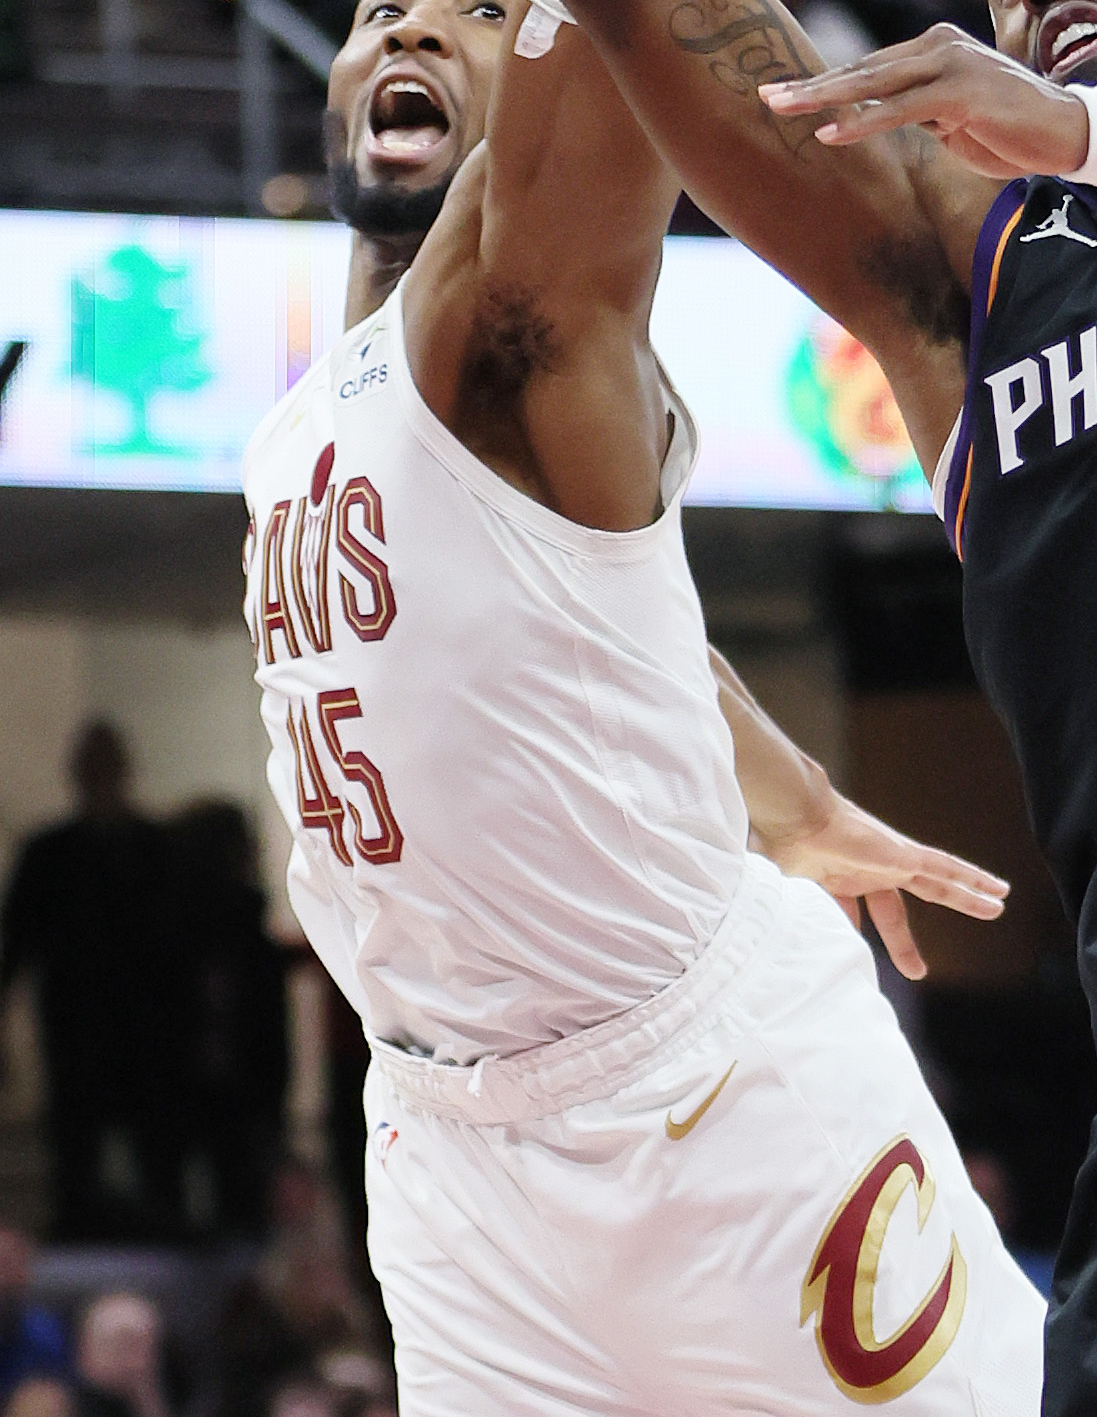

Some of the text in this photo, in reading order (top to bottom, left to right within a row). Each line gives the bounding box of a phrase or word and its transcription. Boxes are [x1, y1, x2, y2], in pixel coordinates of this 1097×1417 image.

[339, 362, 388, 399] CLIFFS
[286, 687, 404, 867] 45
[799, 1132, 967, 1405] C
